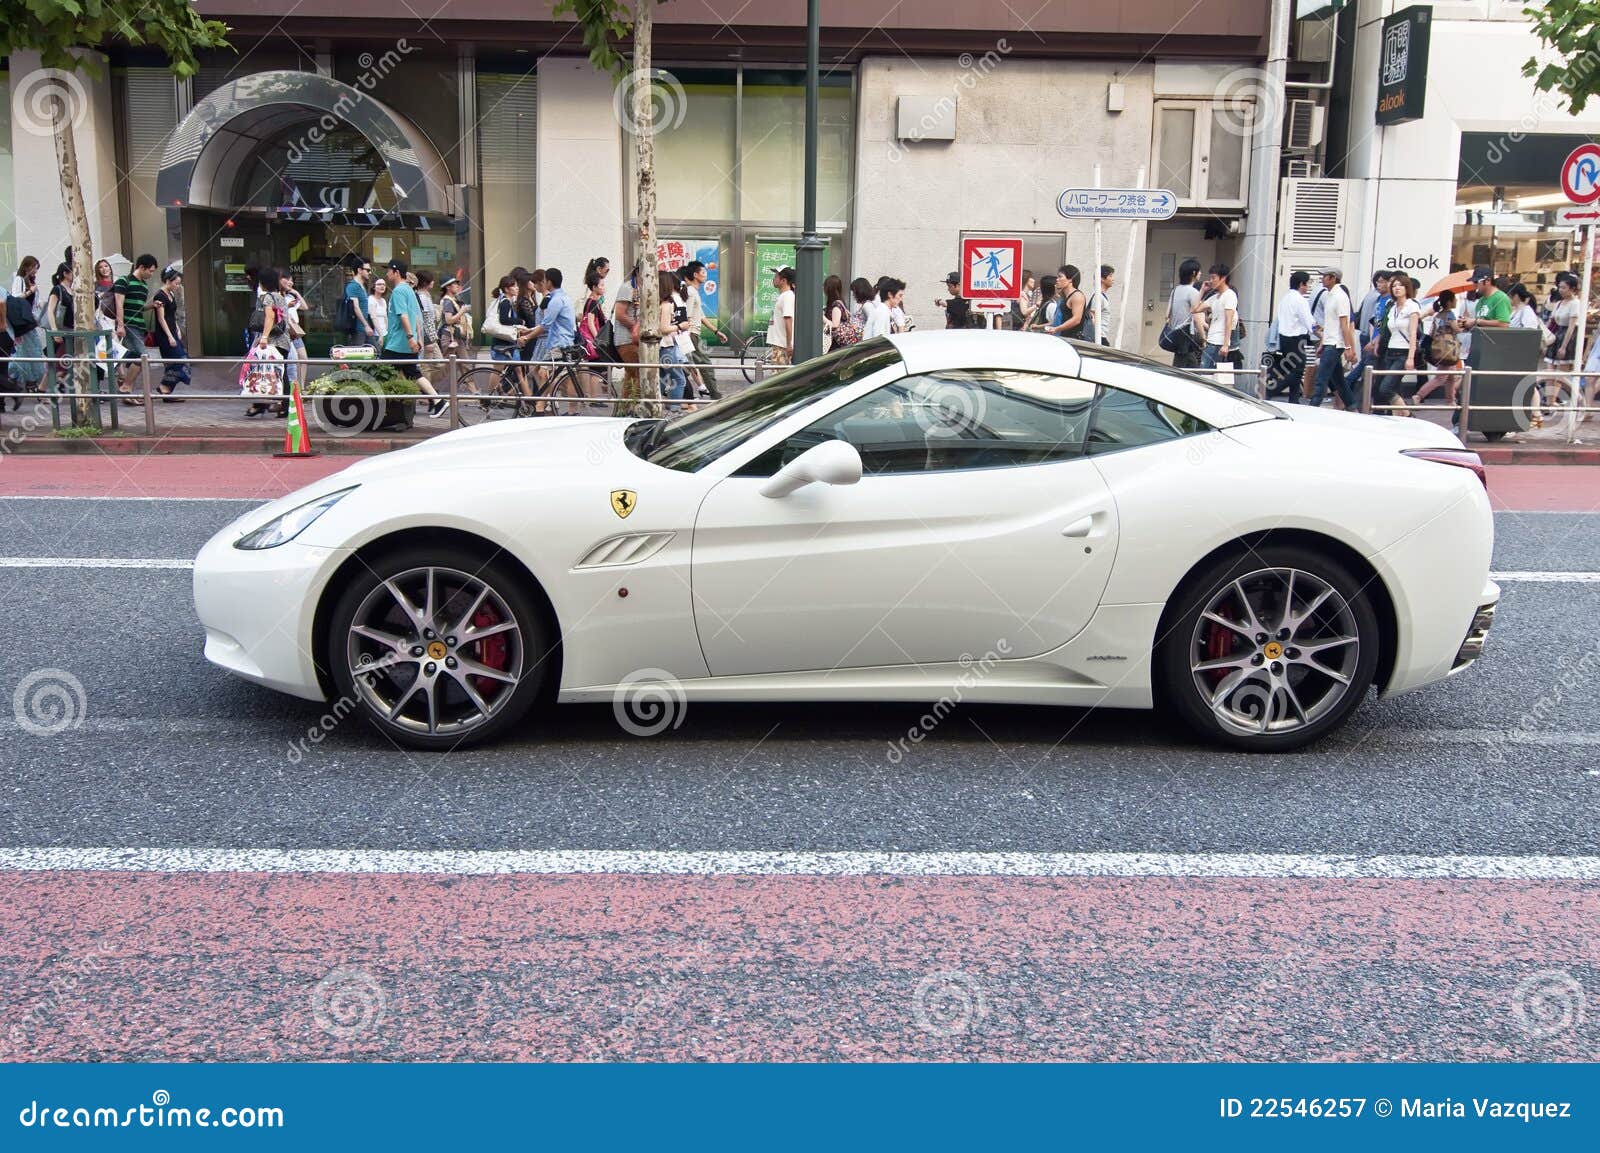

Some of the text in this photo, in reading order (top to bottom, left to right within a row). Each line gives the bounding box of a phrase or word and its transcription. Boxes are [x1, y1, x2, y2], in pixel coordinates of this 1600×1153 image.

[1379, 89, 1405, 112] alook
[1069, 194, 1146, 206] ハローワーク渋谷
[1386, 254, 1439, 269] alook
